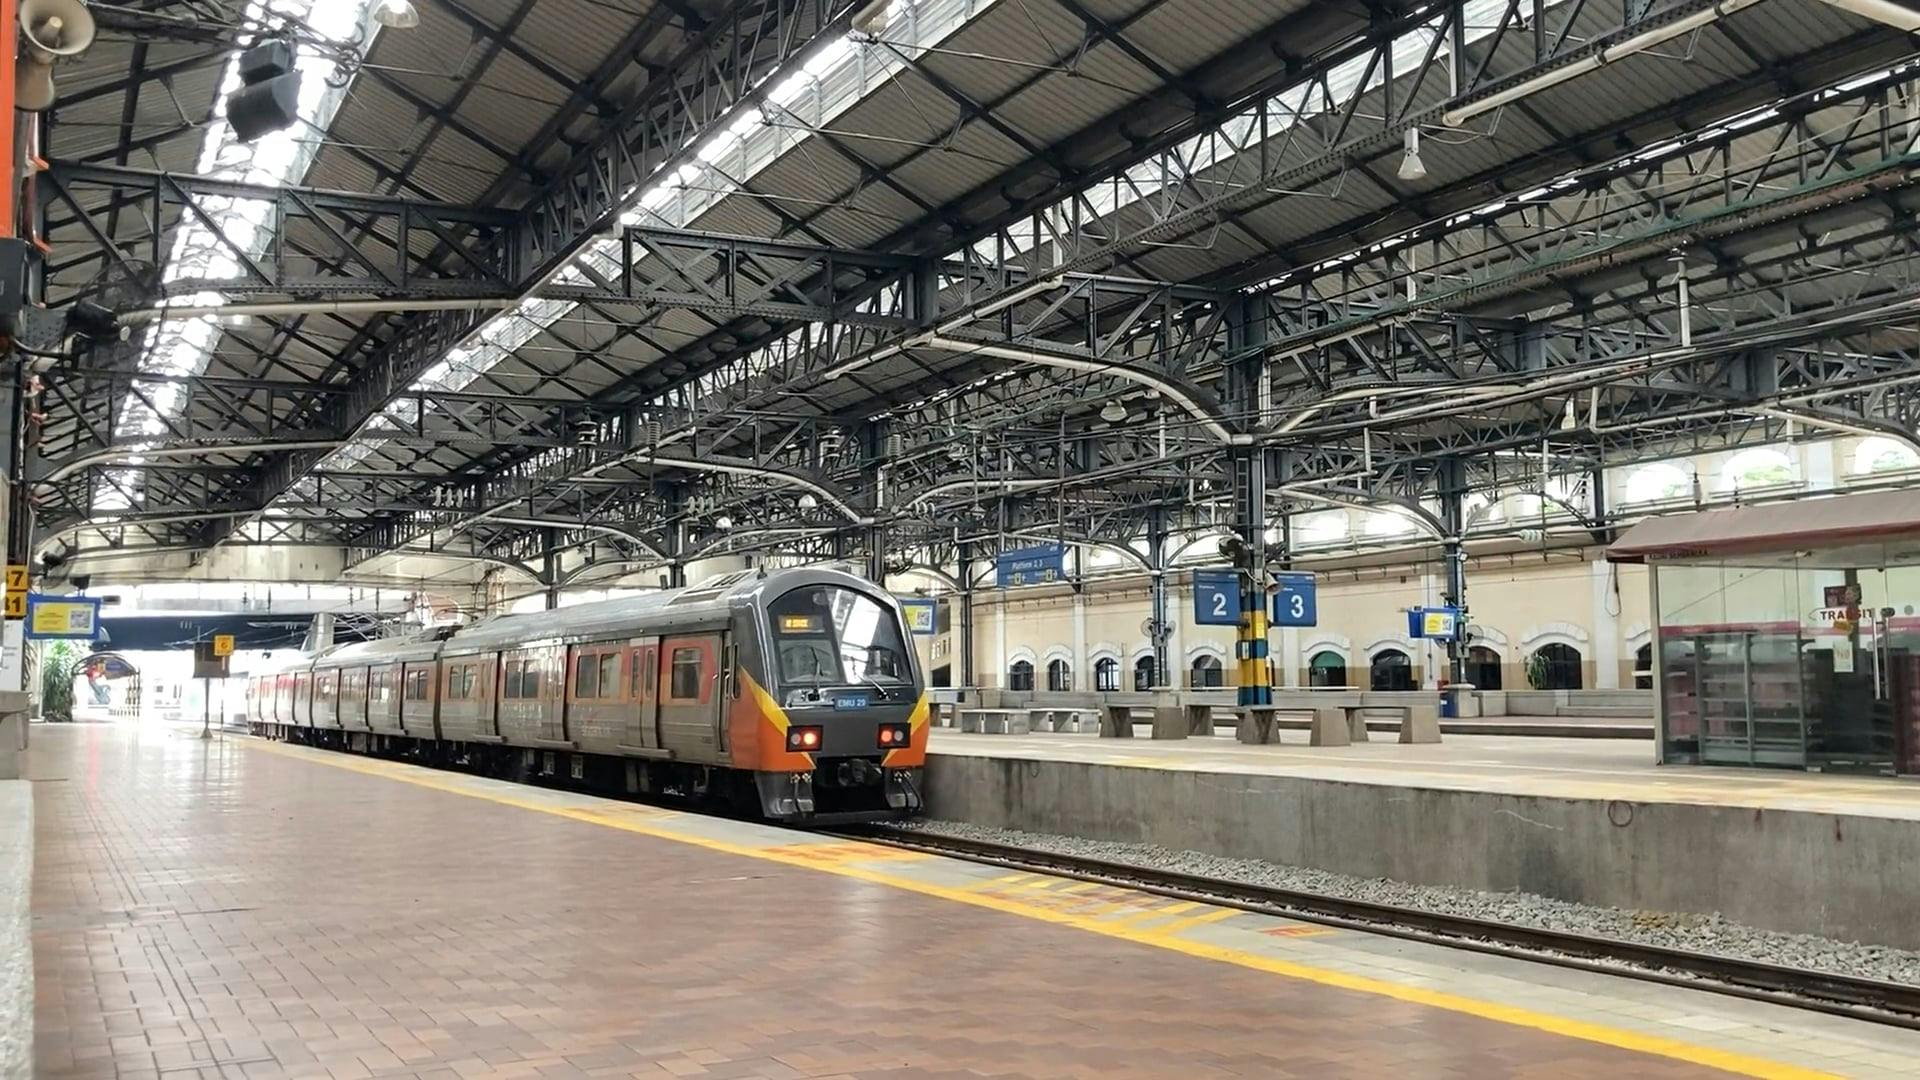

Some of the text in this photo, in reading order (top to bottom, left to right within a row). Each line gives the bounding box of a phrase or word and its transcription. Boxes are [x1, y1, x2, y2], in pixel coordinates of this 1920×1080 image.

[1212, 592, 1227, 616] 2
[1290, 594, 1304, 618] 3
[1820, 608, 1873, 621] TRASIT
[838, 699, 855, 708] EMU
